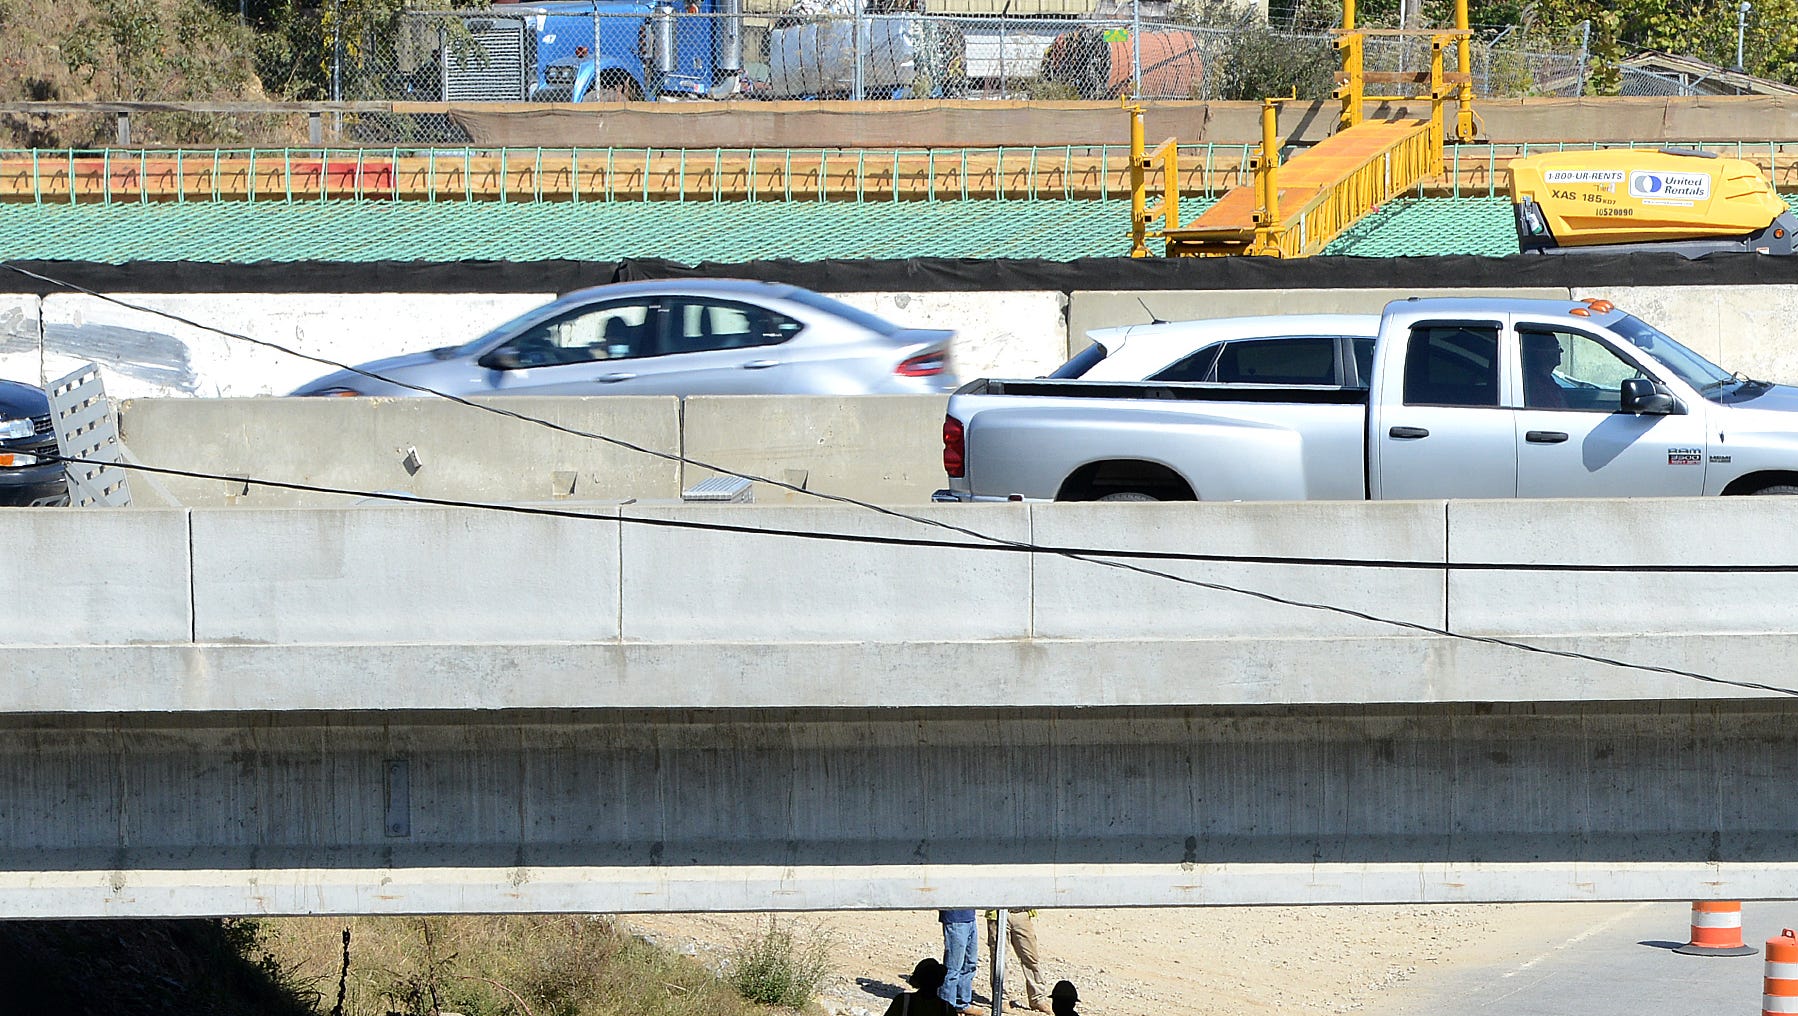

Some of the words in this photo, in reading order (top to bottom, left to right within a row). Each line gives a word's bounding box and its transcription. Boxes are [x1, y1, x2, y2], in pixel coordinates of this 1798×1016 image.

[1664, 176, 1702, 186] United
[1551, 189, 1577, 200] XAS
[1664, 185, 1705, 196] Rentals
